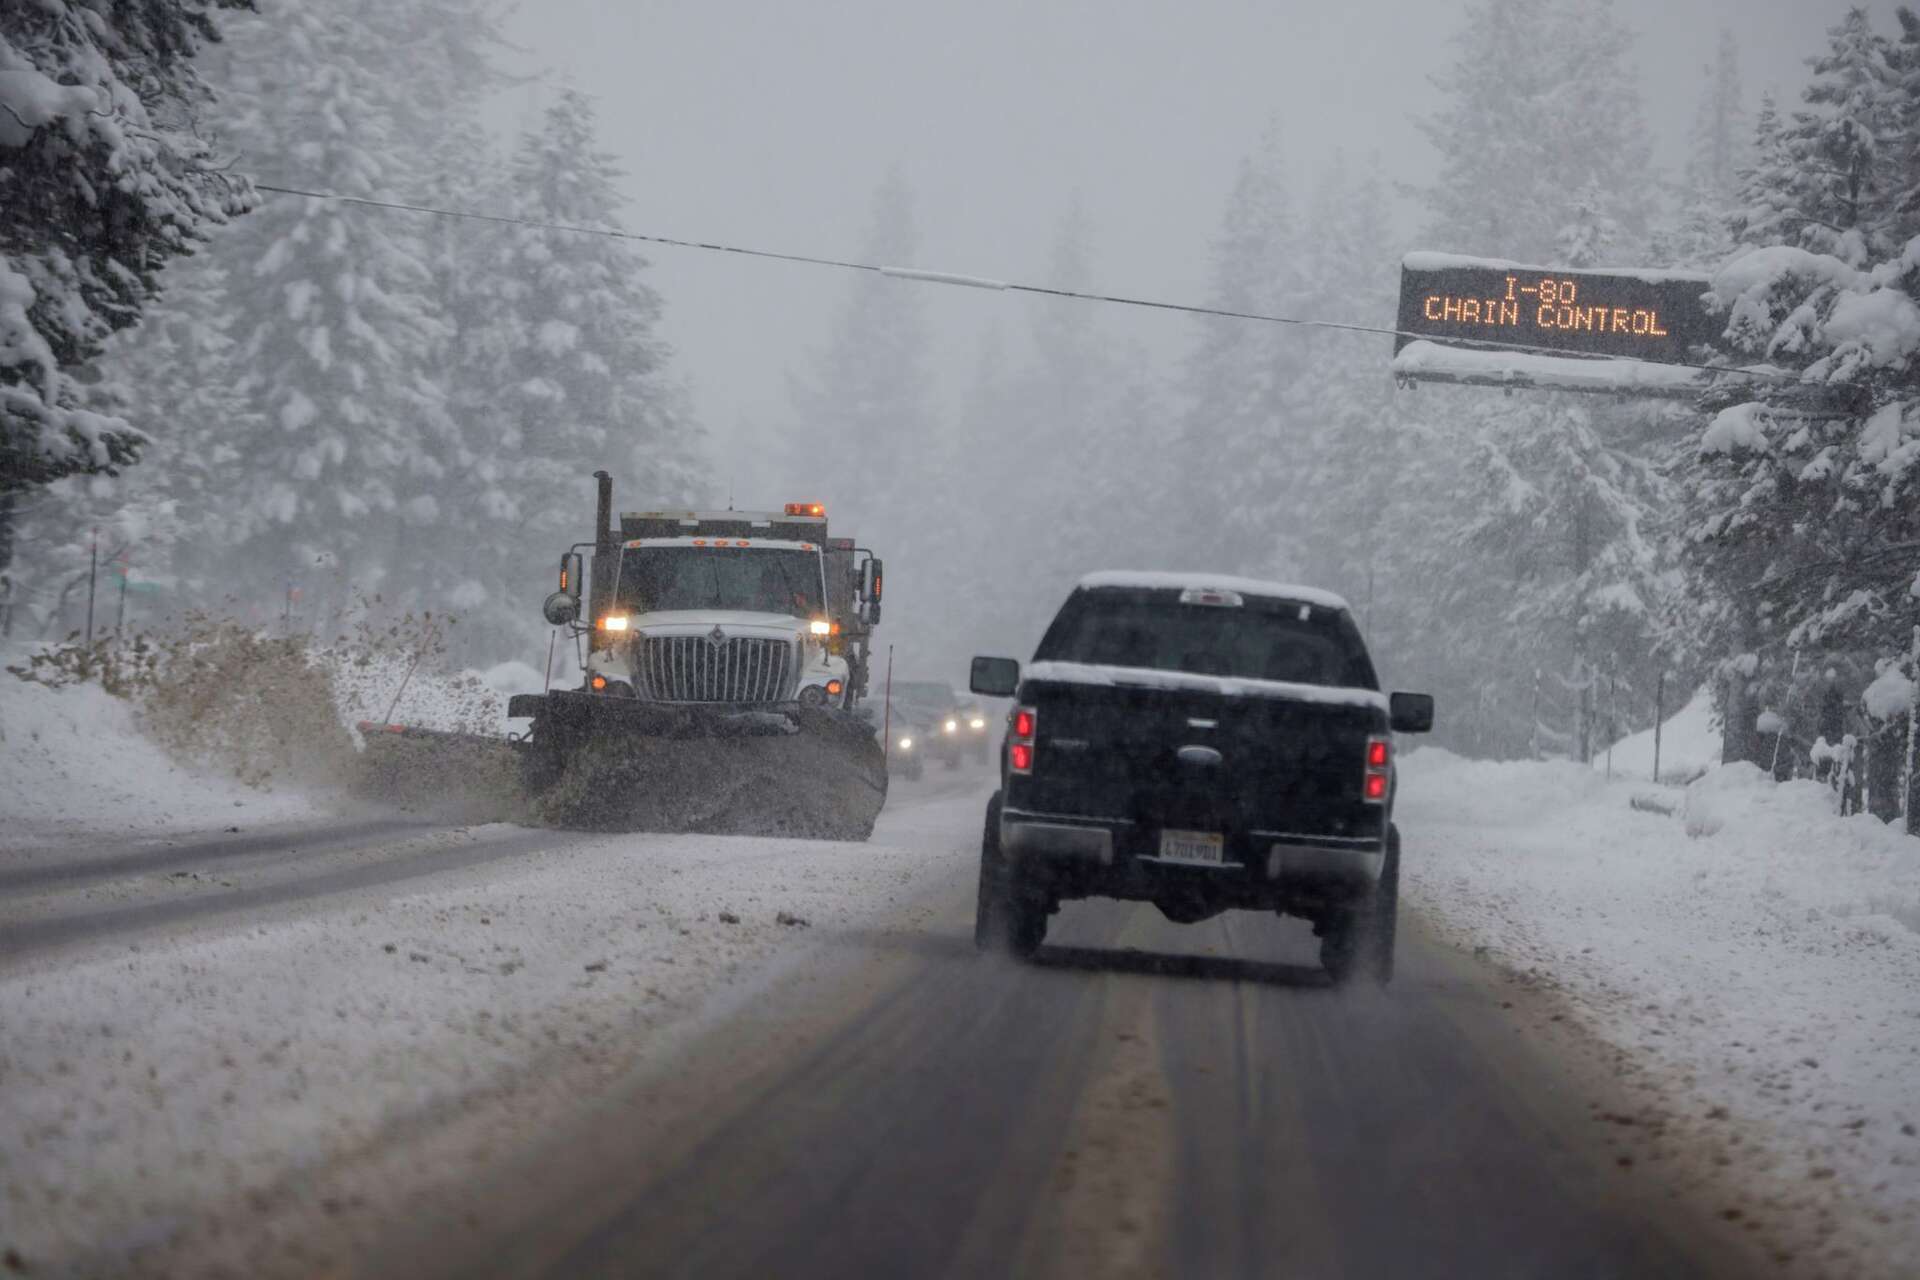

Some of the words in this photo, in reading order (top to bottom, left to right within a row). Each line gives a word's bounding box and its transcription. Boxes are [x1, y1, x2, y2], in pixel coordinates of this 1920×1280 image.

[1505, 277, 1576, 304] I-80
[1424, 296, 1518, 325] CHAIN
[1538, 305, 1667, 336] CONTROL
